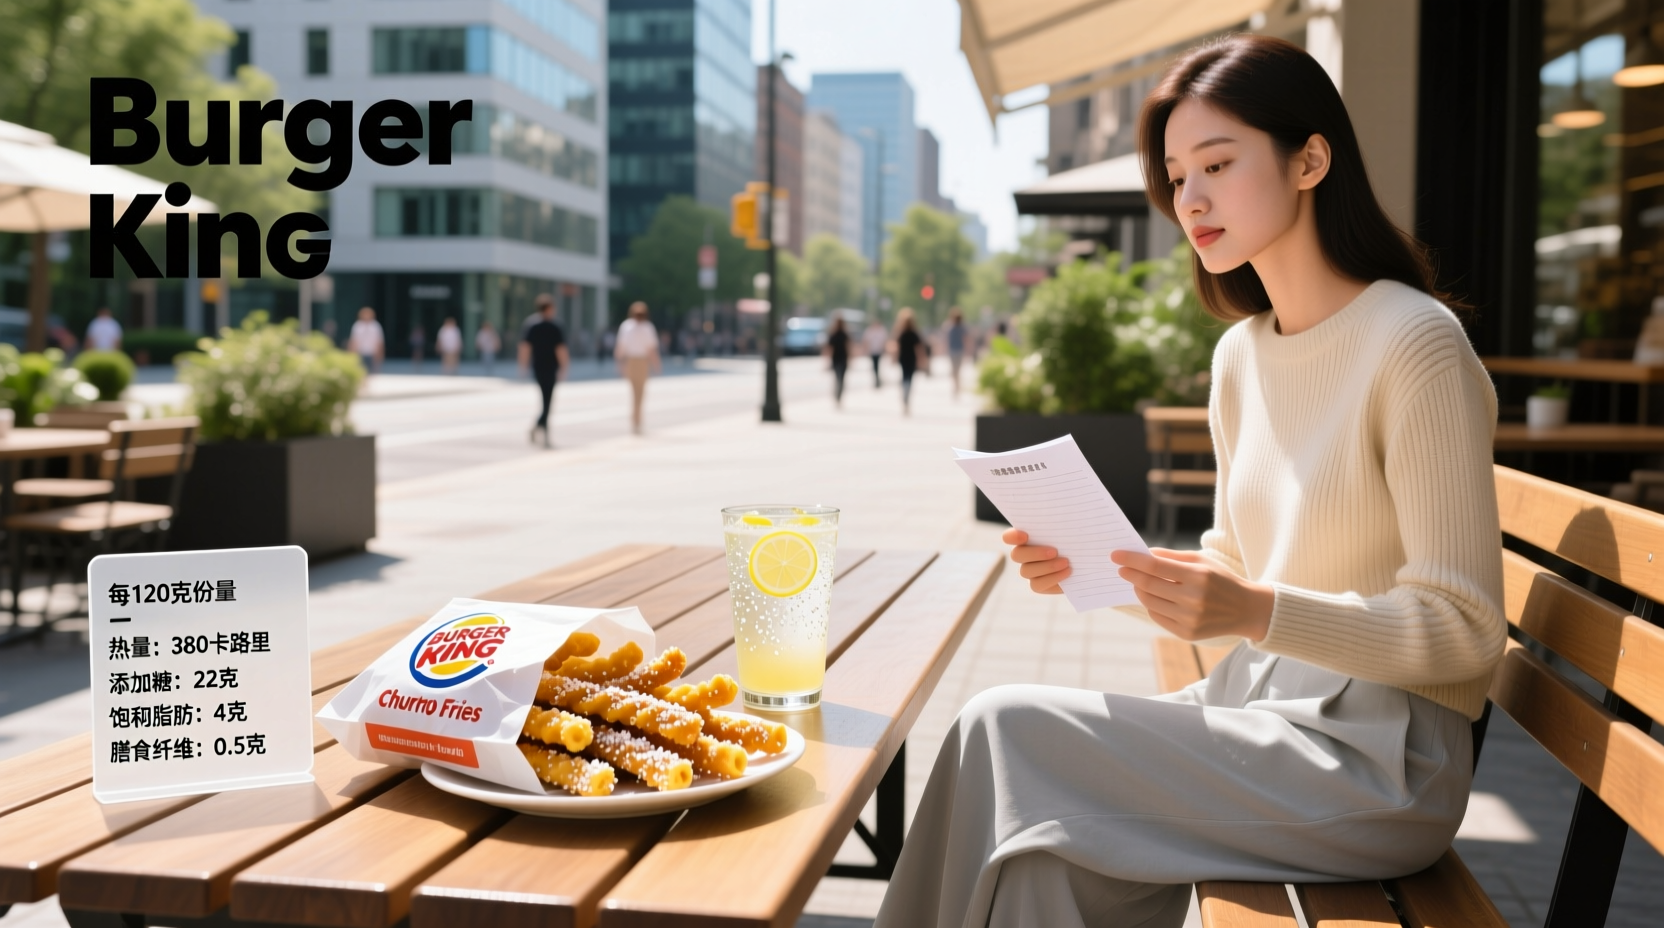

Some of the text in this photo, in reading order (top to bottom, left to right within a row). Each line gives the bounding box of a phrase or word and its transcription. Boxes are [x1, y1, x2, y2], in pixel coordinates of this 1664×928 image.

[108, 579, 237, 607] 每120克份量
[427, 626, 511, 646] BURGER
[416, 638, 505, 669] KING
[439, 698, 483, 723] Fries
